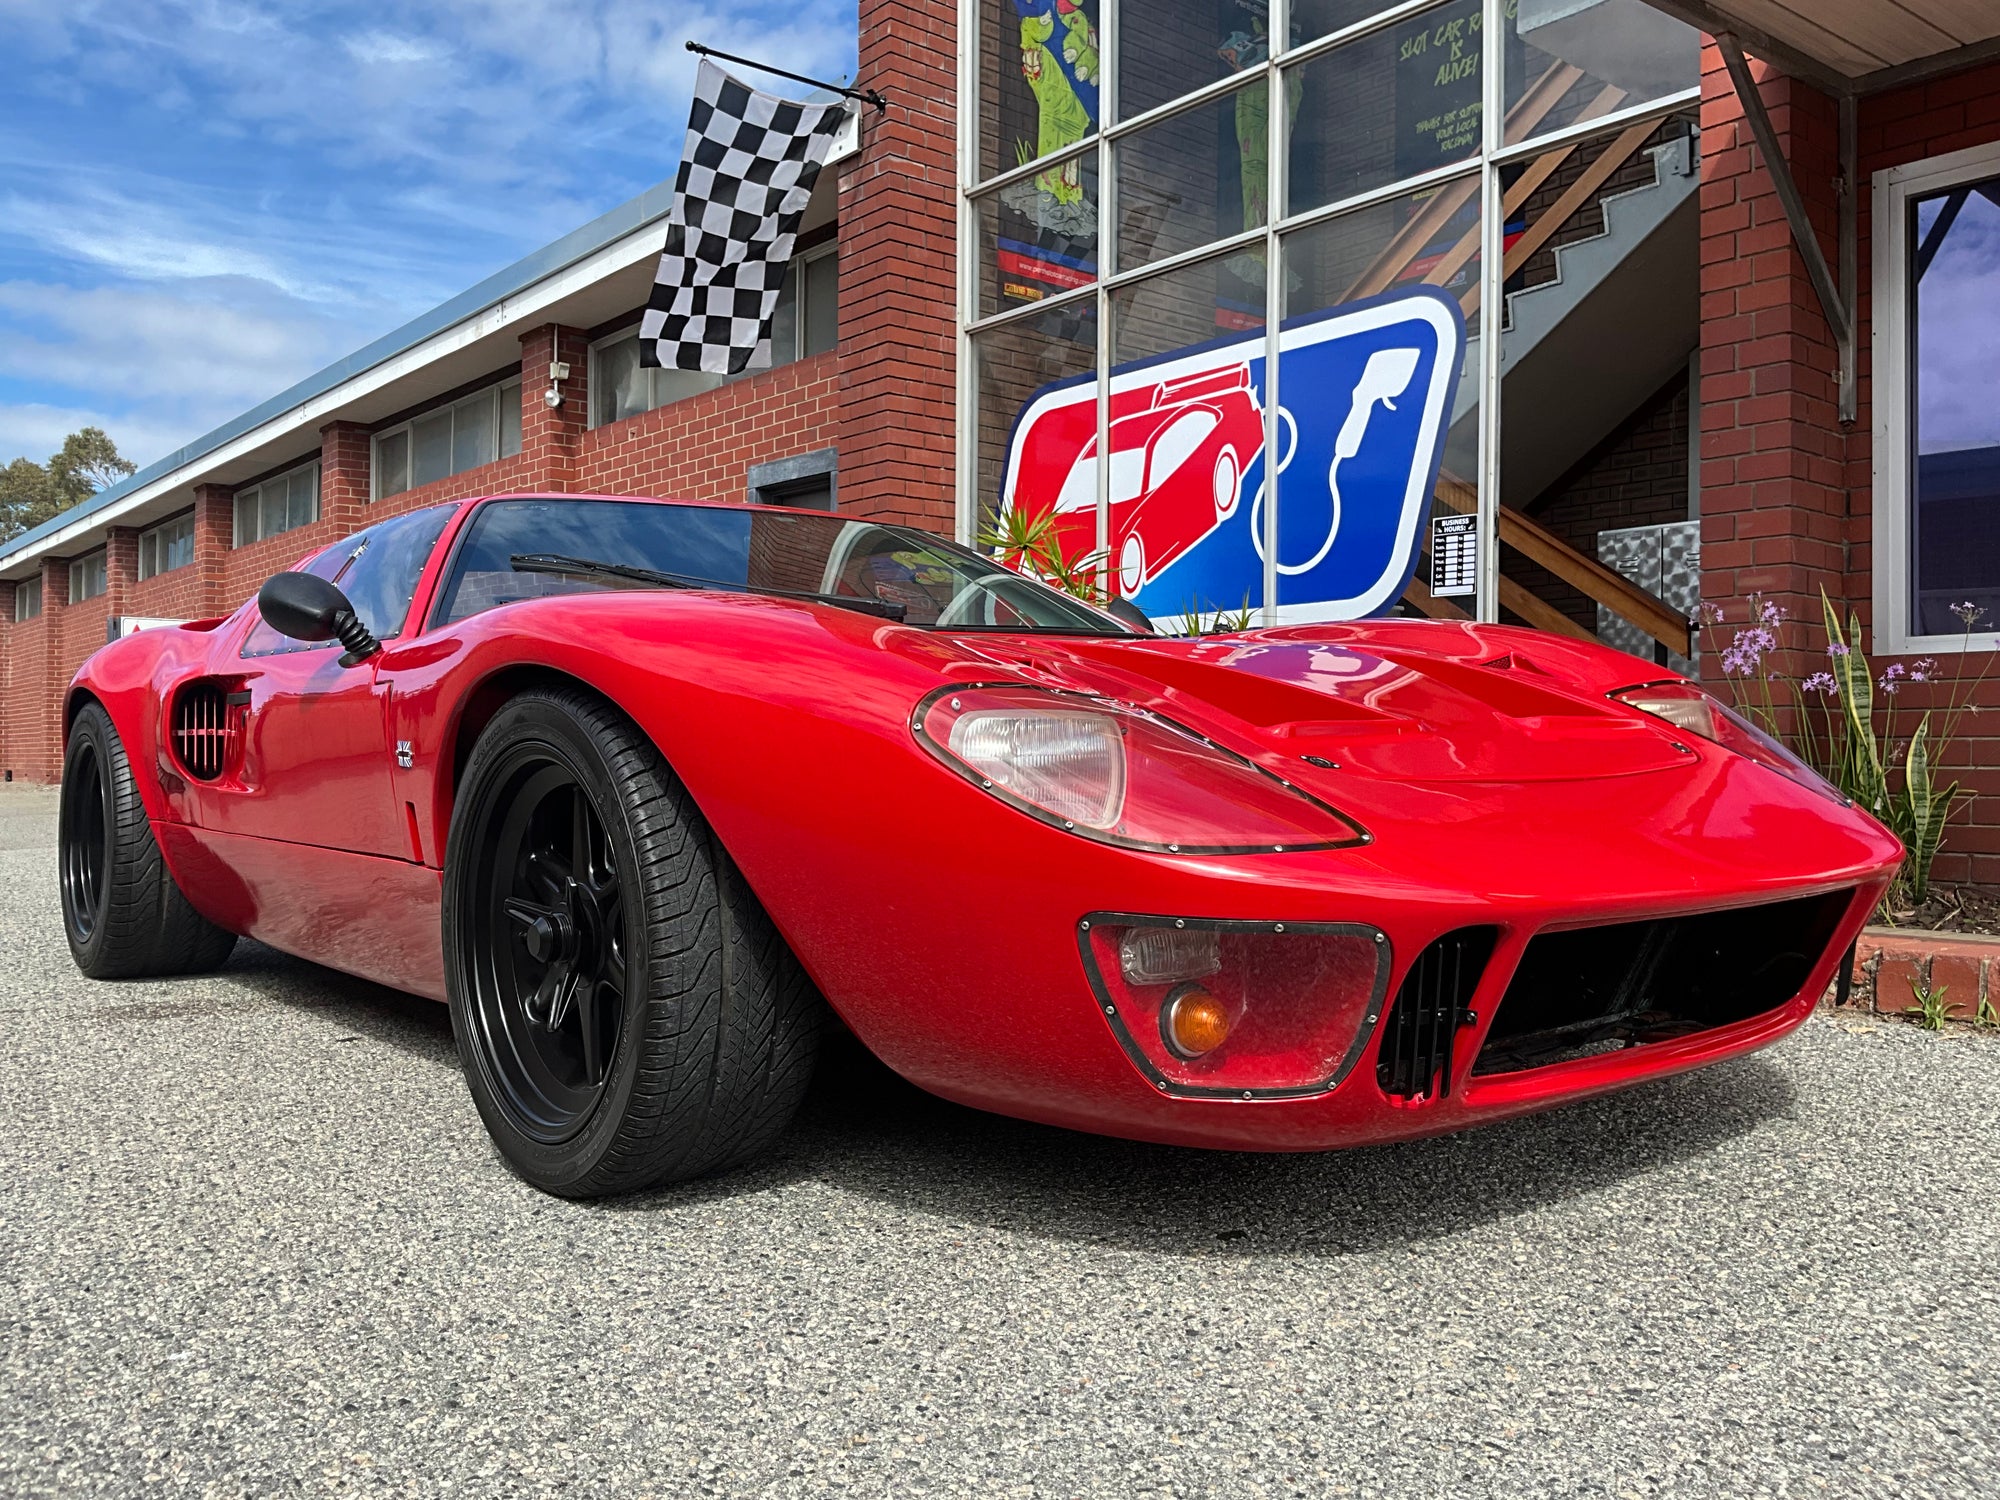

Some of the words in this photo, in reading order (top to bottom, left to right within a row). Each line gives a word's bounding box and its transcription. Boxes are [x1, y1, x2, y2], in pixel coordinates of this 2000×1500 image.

[1399, 30, 1429, 61] SLOT
[1433, 18, 1465, 47] CAR
[1450, 39, 1463, 62] IS
[1434, 52, 1479, 87] ALIVE!
[1441, 518, 1469, 527] BUSINESS
